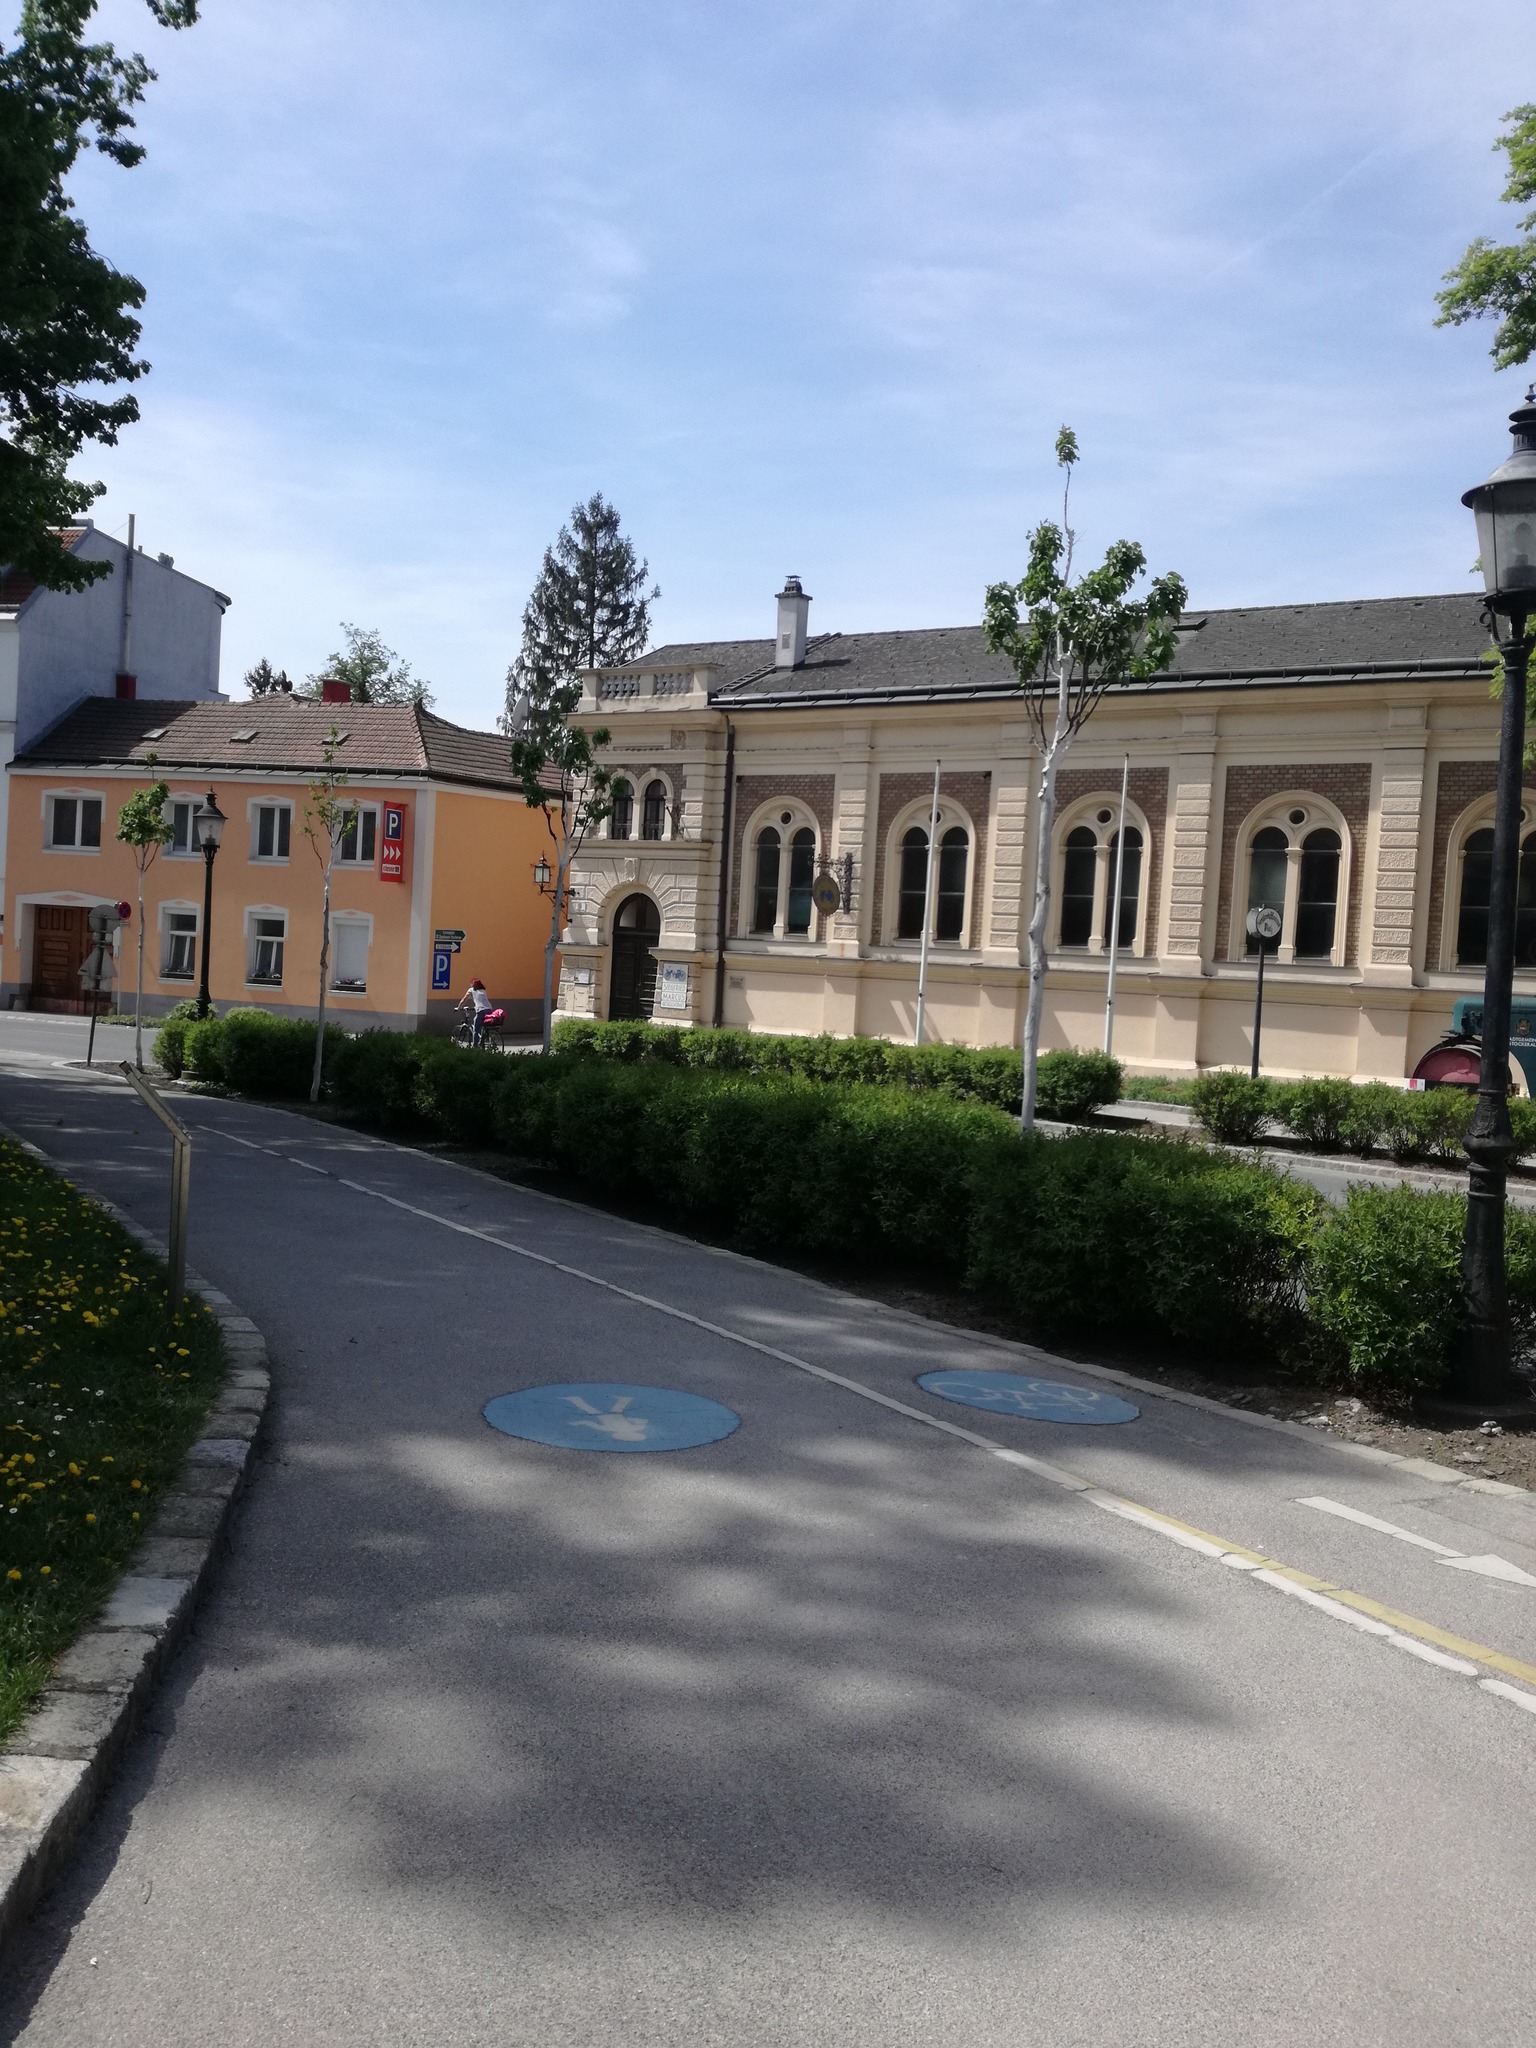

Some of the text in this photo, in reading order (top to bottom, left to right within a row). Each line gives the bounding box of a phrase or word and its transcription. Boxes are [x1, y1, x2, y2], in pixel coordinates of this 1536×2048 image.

[388, 813, 399, 836] P
[435, 954, 448, 981] P
[663, 993, 685, 1001] MARCUS
